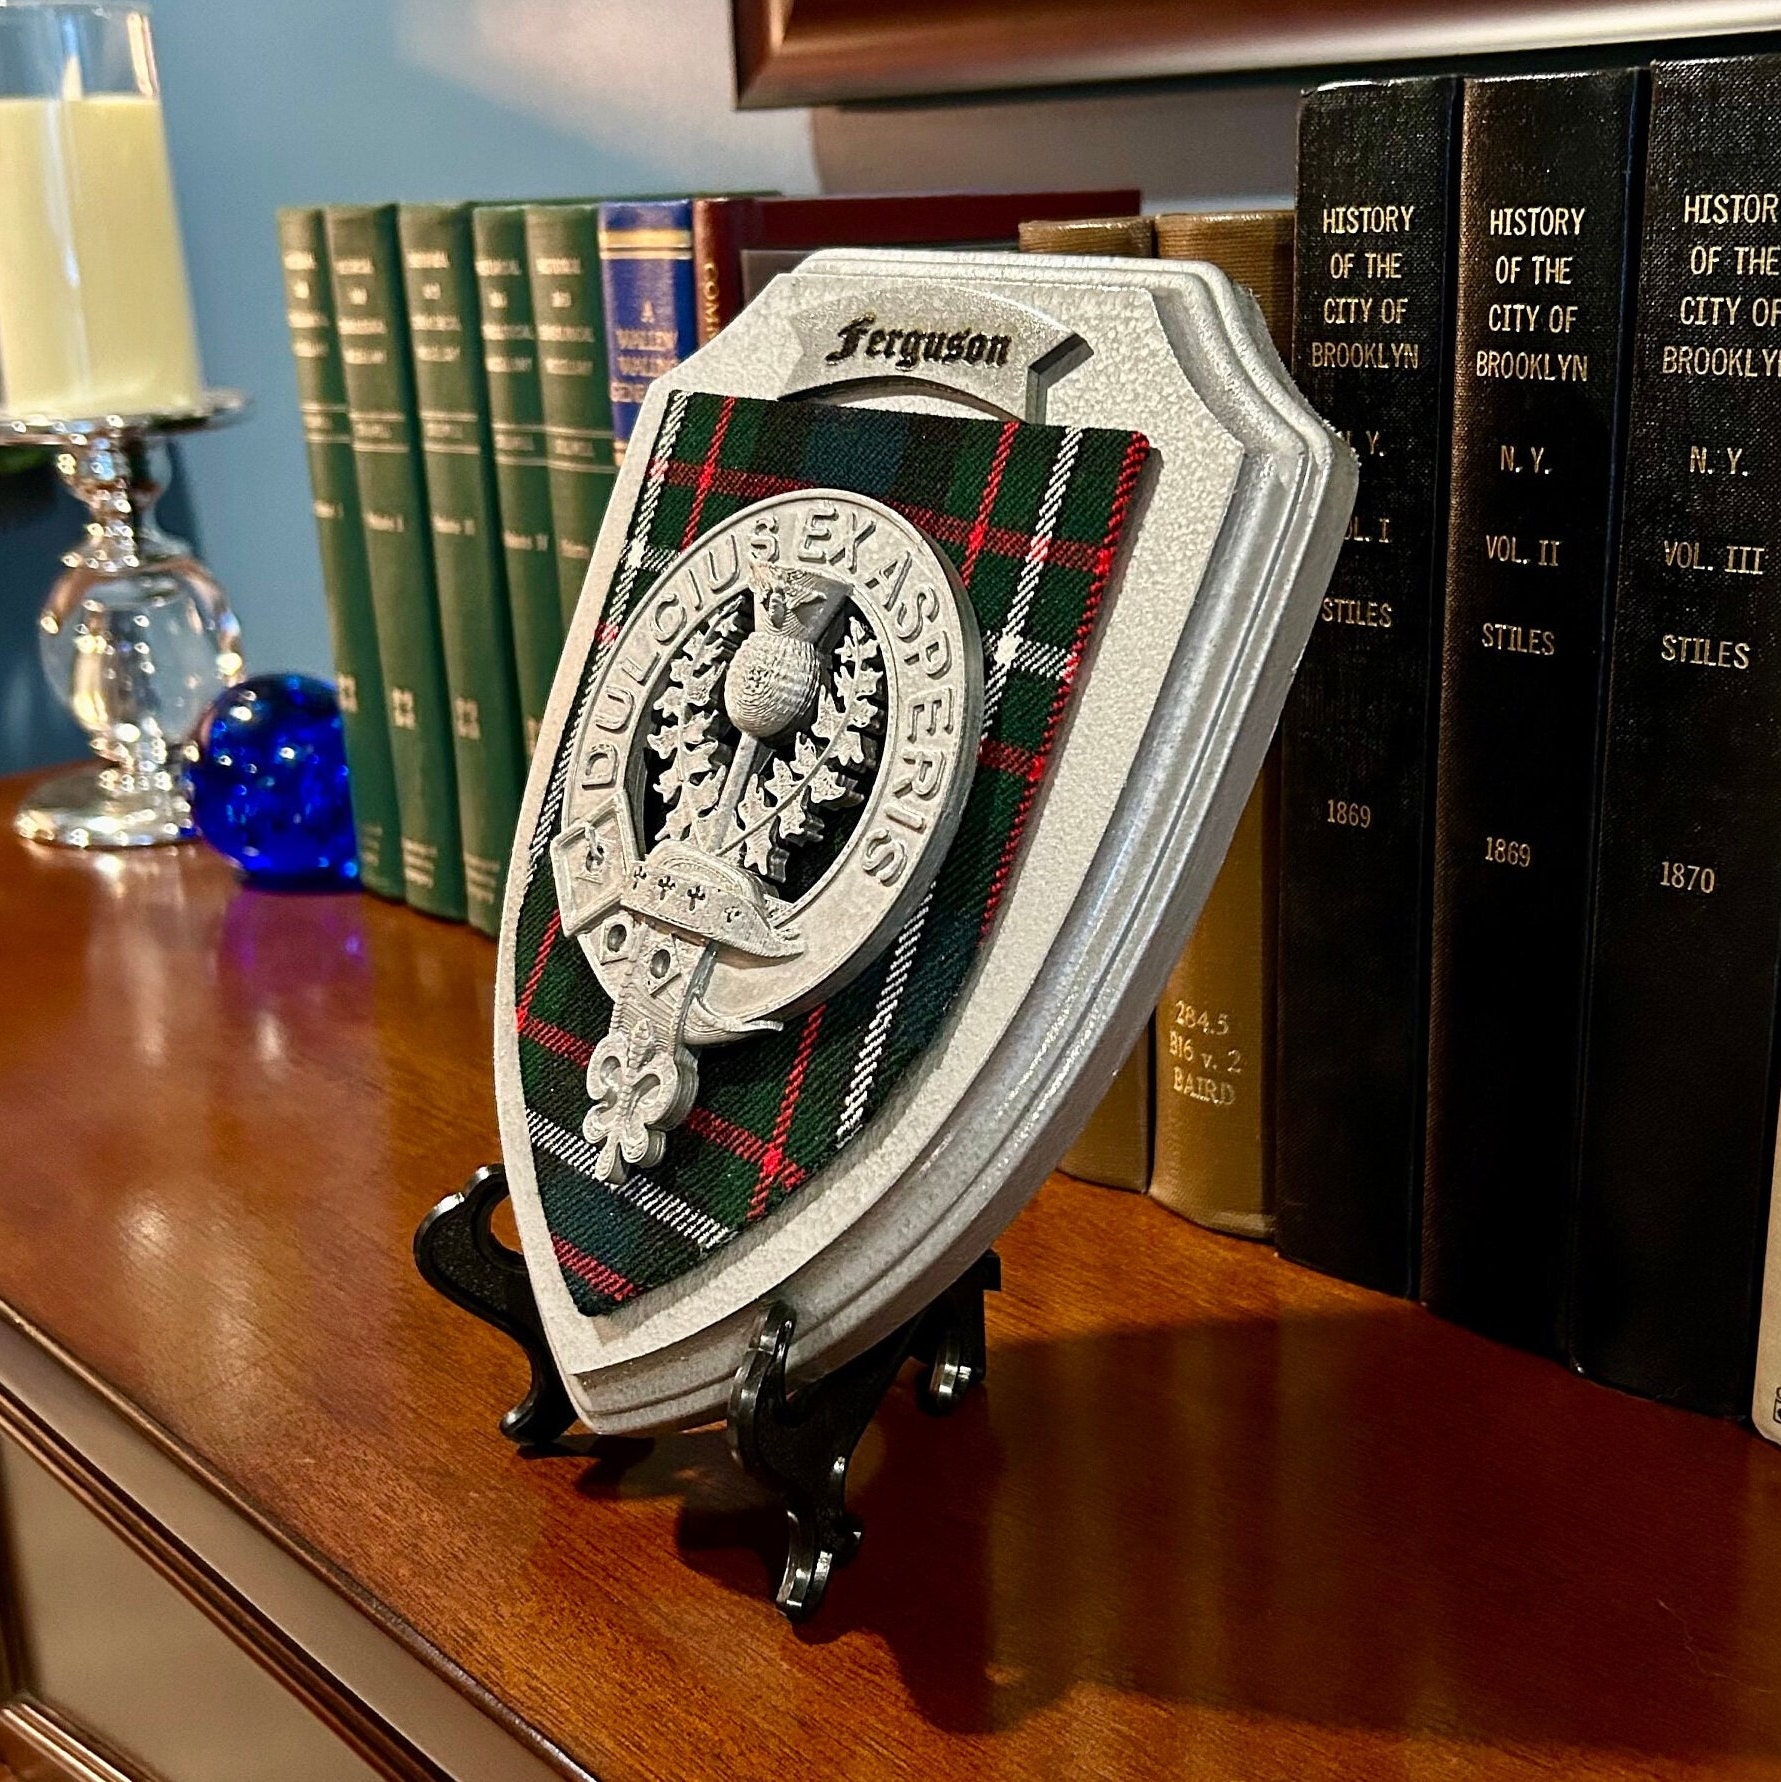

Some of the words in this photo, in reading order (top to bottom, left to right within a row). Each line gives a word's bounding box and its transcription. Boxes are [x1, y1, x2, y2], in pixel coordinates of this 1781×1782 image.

[1322, 206, 1414, 234] HISTORY
[1489, 208, 1585, 236] HISTORY
[1330, 253, 1354, 279] OF
[1365, 253, 1402, 279] THE
[1495, 256, 1521, 285] OF
[1531, 256, 1573, 285] THE
[1690, 246, 1722, 276] OF
[1733, 246, 1781, 276] THE
[1323, 298, 1372, 324] CITY
[1381, 297, 1409, 324] OF
[1488, 304, 1538, 331] CITY
[1549, 305, 1578, 333] OF
[1679, 295, 1741, 326] CITY
[825, 311, 1012, 371] Ferguson
[1311, 342, 1419, 369] BROOKLYN
[1476, 350, 1588, 382] BROOKLYN
[1661, 346, 1781, 377] BROOKLY
[1500, 445, 1521, 473] N.
[1530, 446, 1552, 475] Y.
[1689, 445, 1714, 475] N.
[1727, 448, 1748, 475] Y.
[1378, 517, 1391, 543] I
[1486, 535, 1528, 569] VOL.
[1538, 540, 1560, 566] II
[1663, 540, 1714, 570] VOL.
[1725, 546, 1764, 574] III
[1321, 598, 1393, 628] STILES
[1481, 623, 1555, 656] STILES
[1661, 634, 1750, 670] STILES
[581, 514, 780, 789] DULCIUS
[797, 500, 876, 573] EX
[860, 549, 955, 885] ASPERIS
[1327, 800, 1371, 829] 1869
[1485, 837, 1531, 868] 1869
[1660, 861, 1716, 894] 1870
[1175, 1000, 1229, 1036] 284.5
[1201, 1053, 1218, 1071] v.
[1227, 1049, 1242, 1073] 2
[1173, 1066, 1236, 1105] BAIRD
